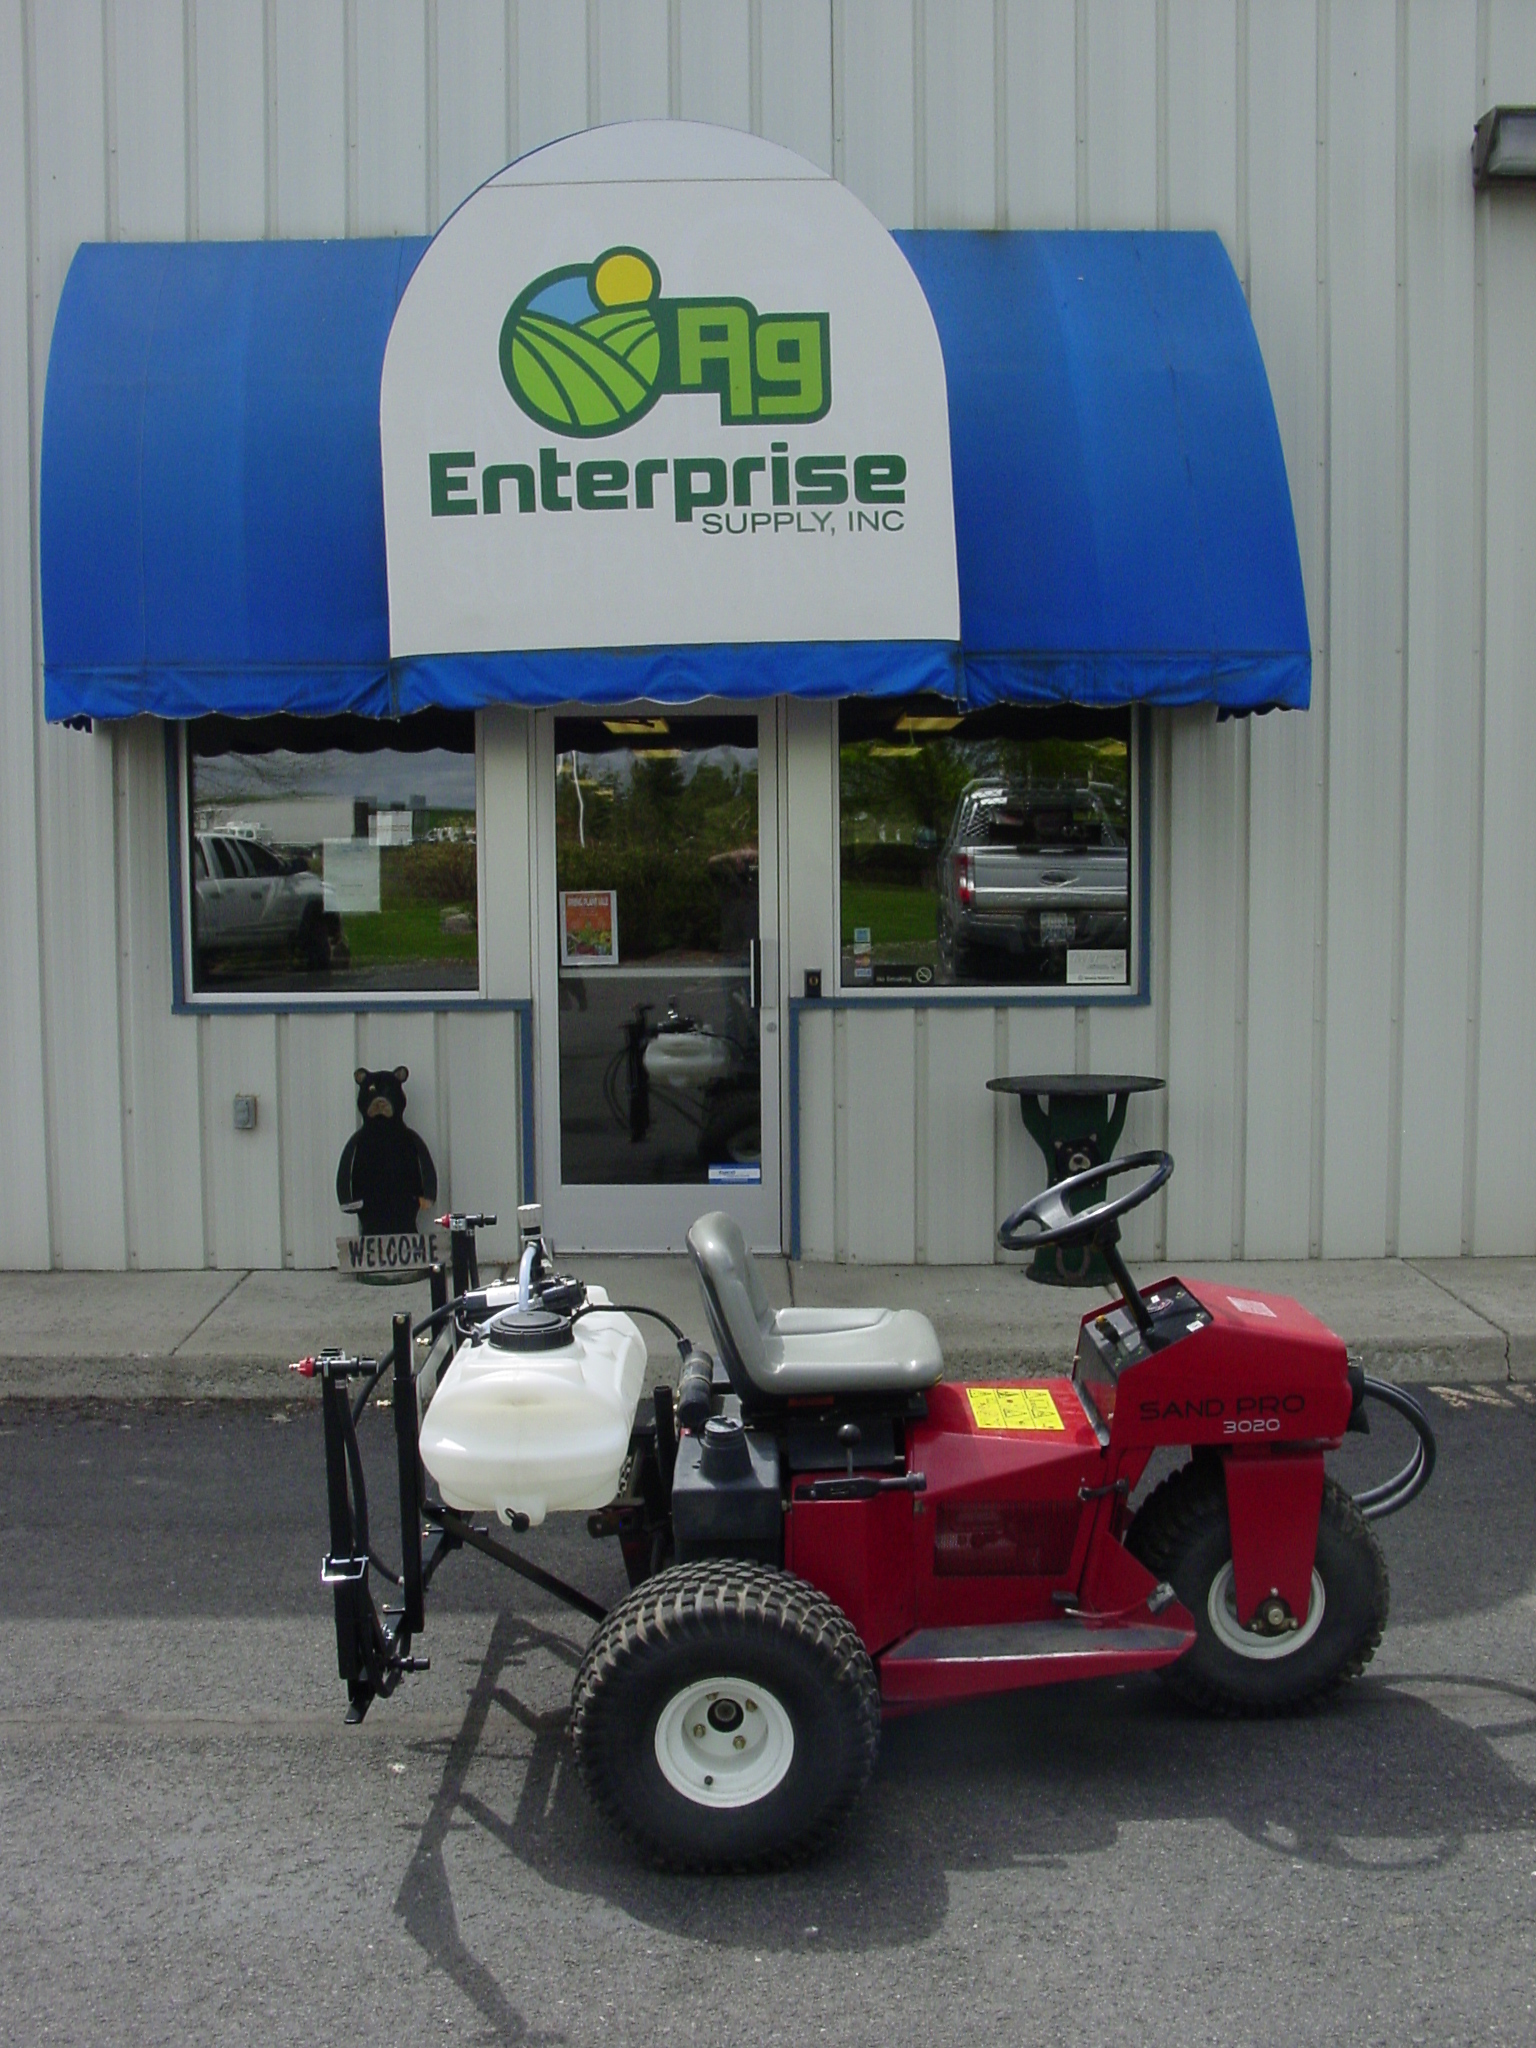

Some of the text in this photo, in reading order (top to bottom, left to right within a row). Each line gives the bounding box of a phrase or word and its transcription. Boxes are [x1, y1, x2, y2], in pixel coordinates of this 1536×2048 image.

[672, 302, 828, 419] Ag
[428, 441, 907, 523] Enterprise
[701, 510, 905, 536] SUPPLY, INC
[348, 1234, 438, 1268] WELCOME
[1139, 1394, 1306, 1420] SAND PRO
[1222, 1418, 1280, 1434] 3020
